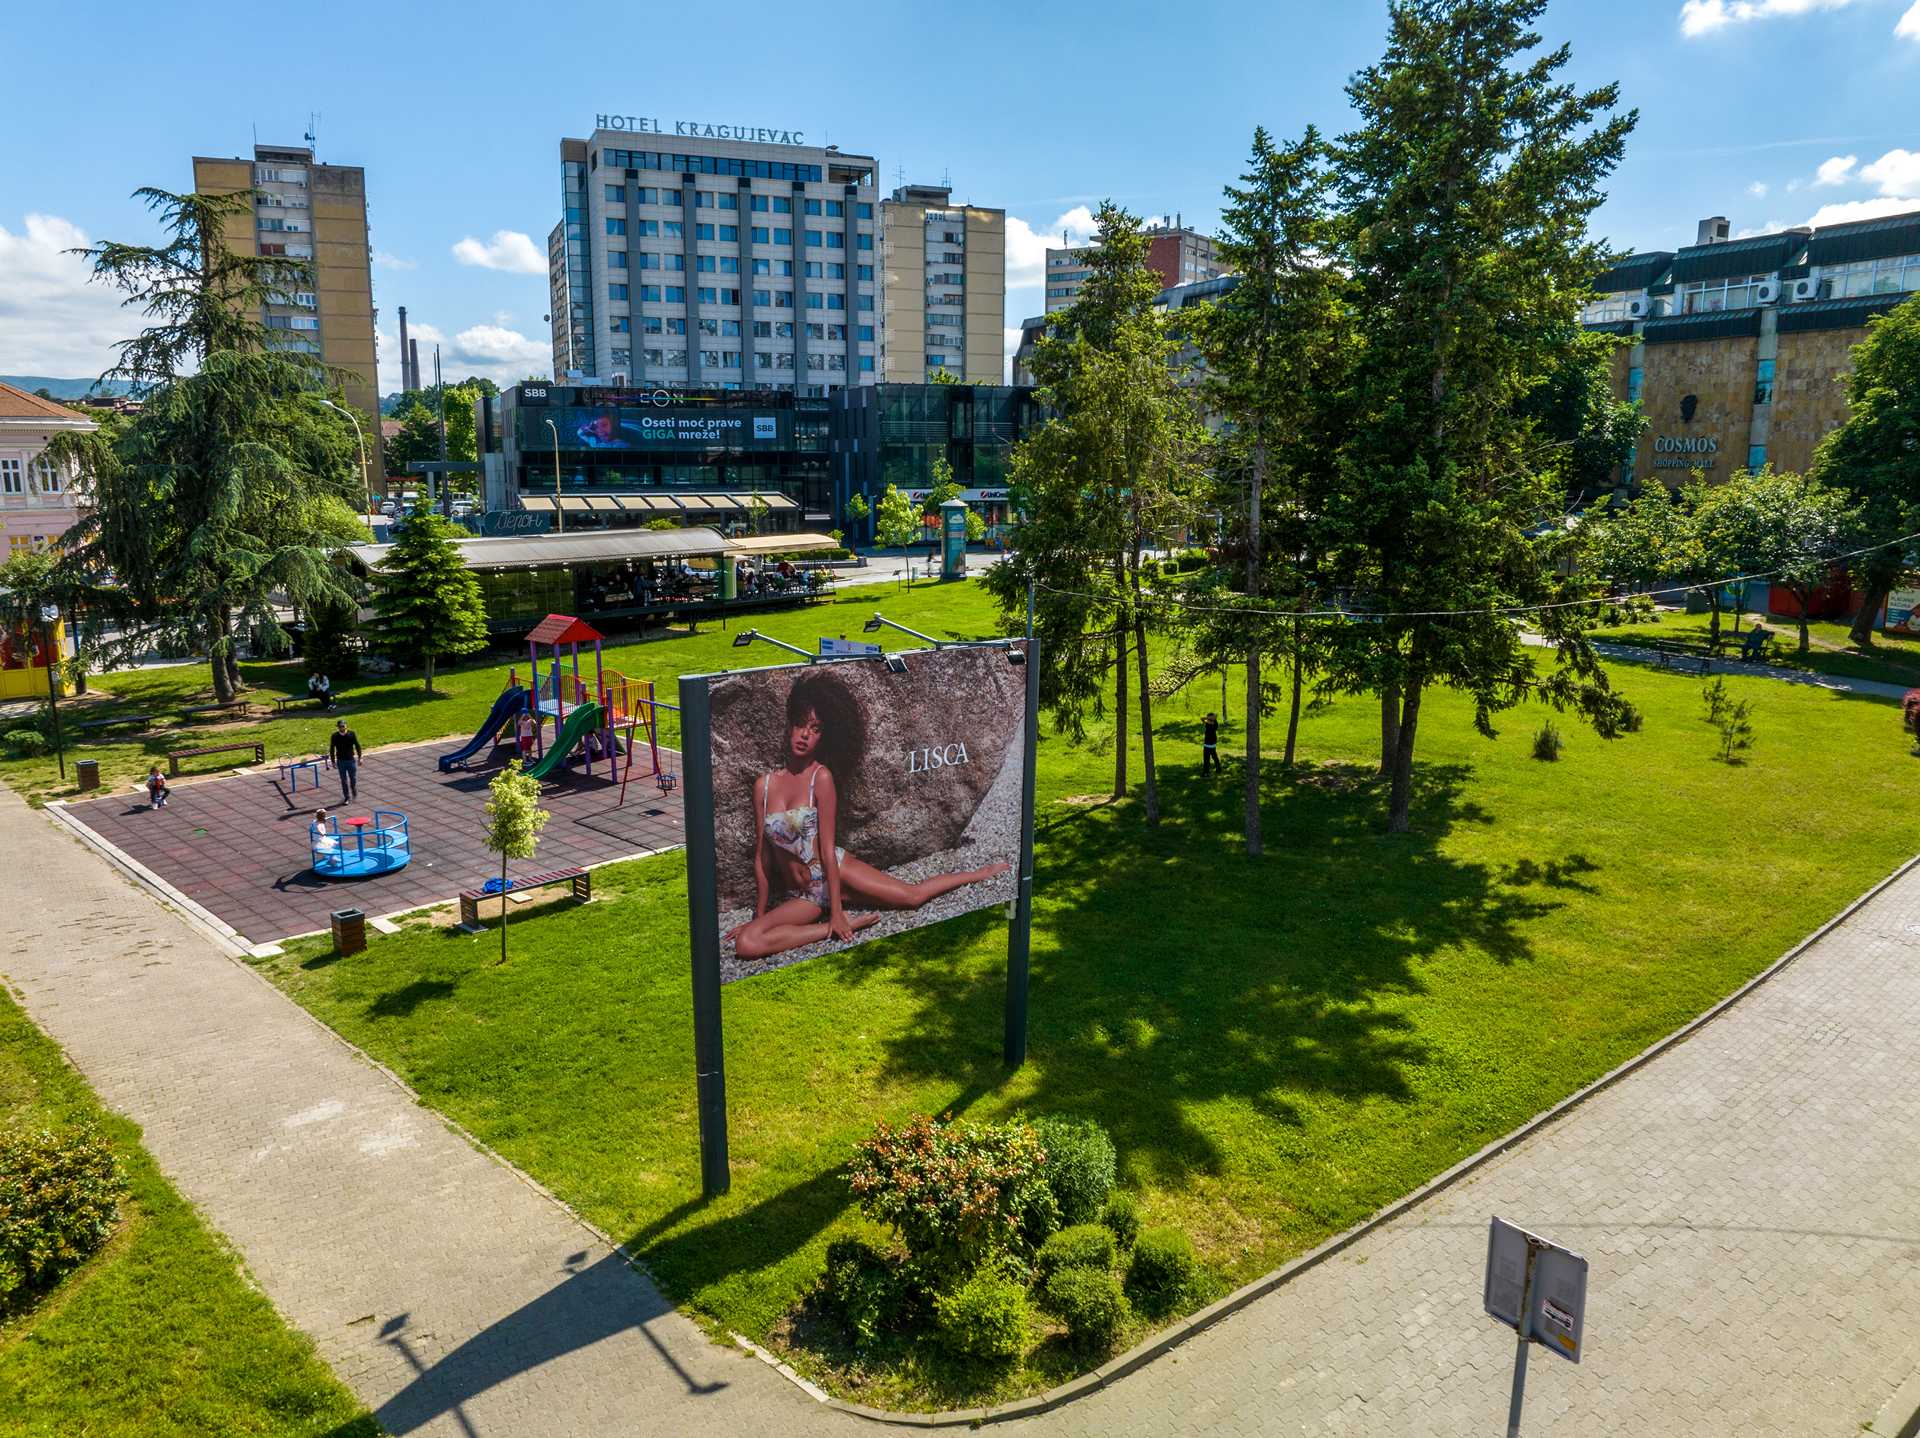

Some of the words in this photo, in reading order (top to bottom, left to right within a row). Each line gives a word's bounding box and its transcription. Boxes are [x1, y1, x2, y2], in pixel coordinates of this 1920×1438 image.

[596, 114, 662, 133] HOTEL
[676, 121, 804, 145] KRAGUJEVAC
[525, 389, 546, 397] SBB
[640, 389, 684, 407] EON
[642, 417, 675, 428] Oseti
[678, 417, 705, 428] moć
[708, 419, 742, 430] prave
[755, 424, 775, 432] SBB
[642, 429, 676, 440] GIGA
[678, 429, 720, 440] mreže!
[1654, 437, 1717, 453] COSMOS
[909, 741, 969, 774] LISCA
